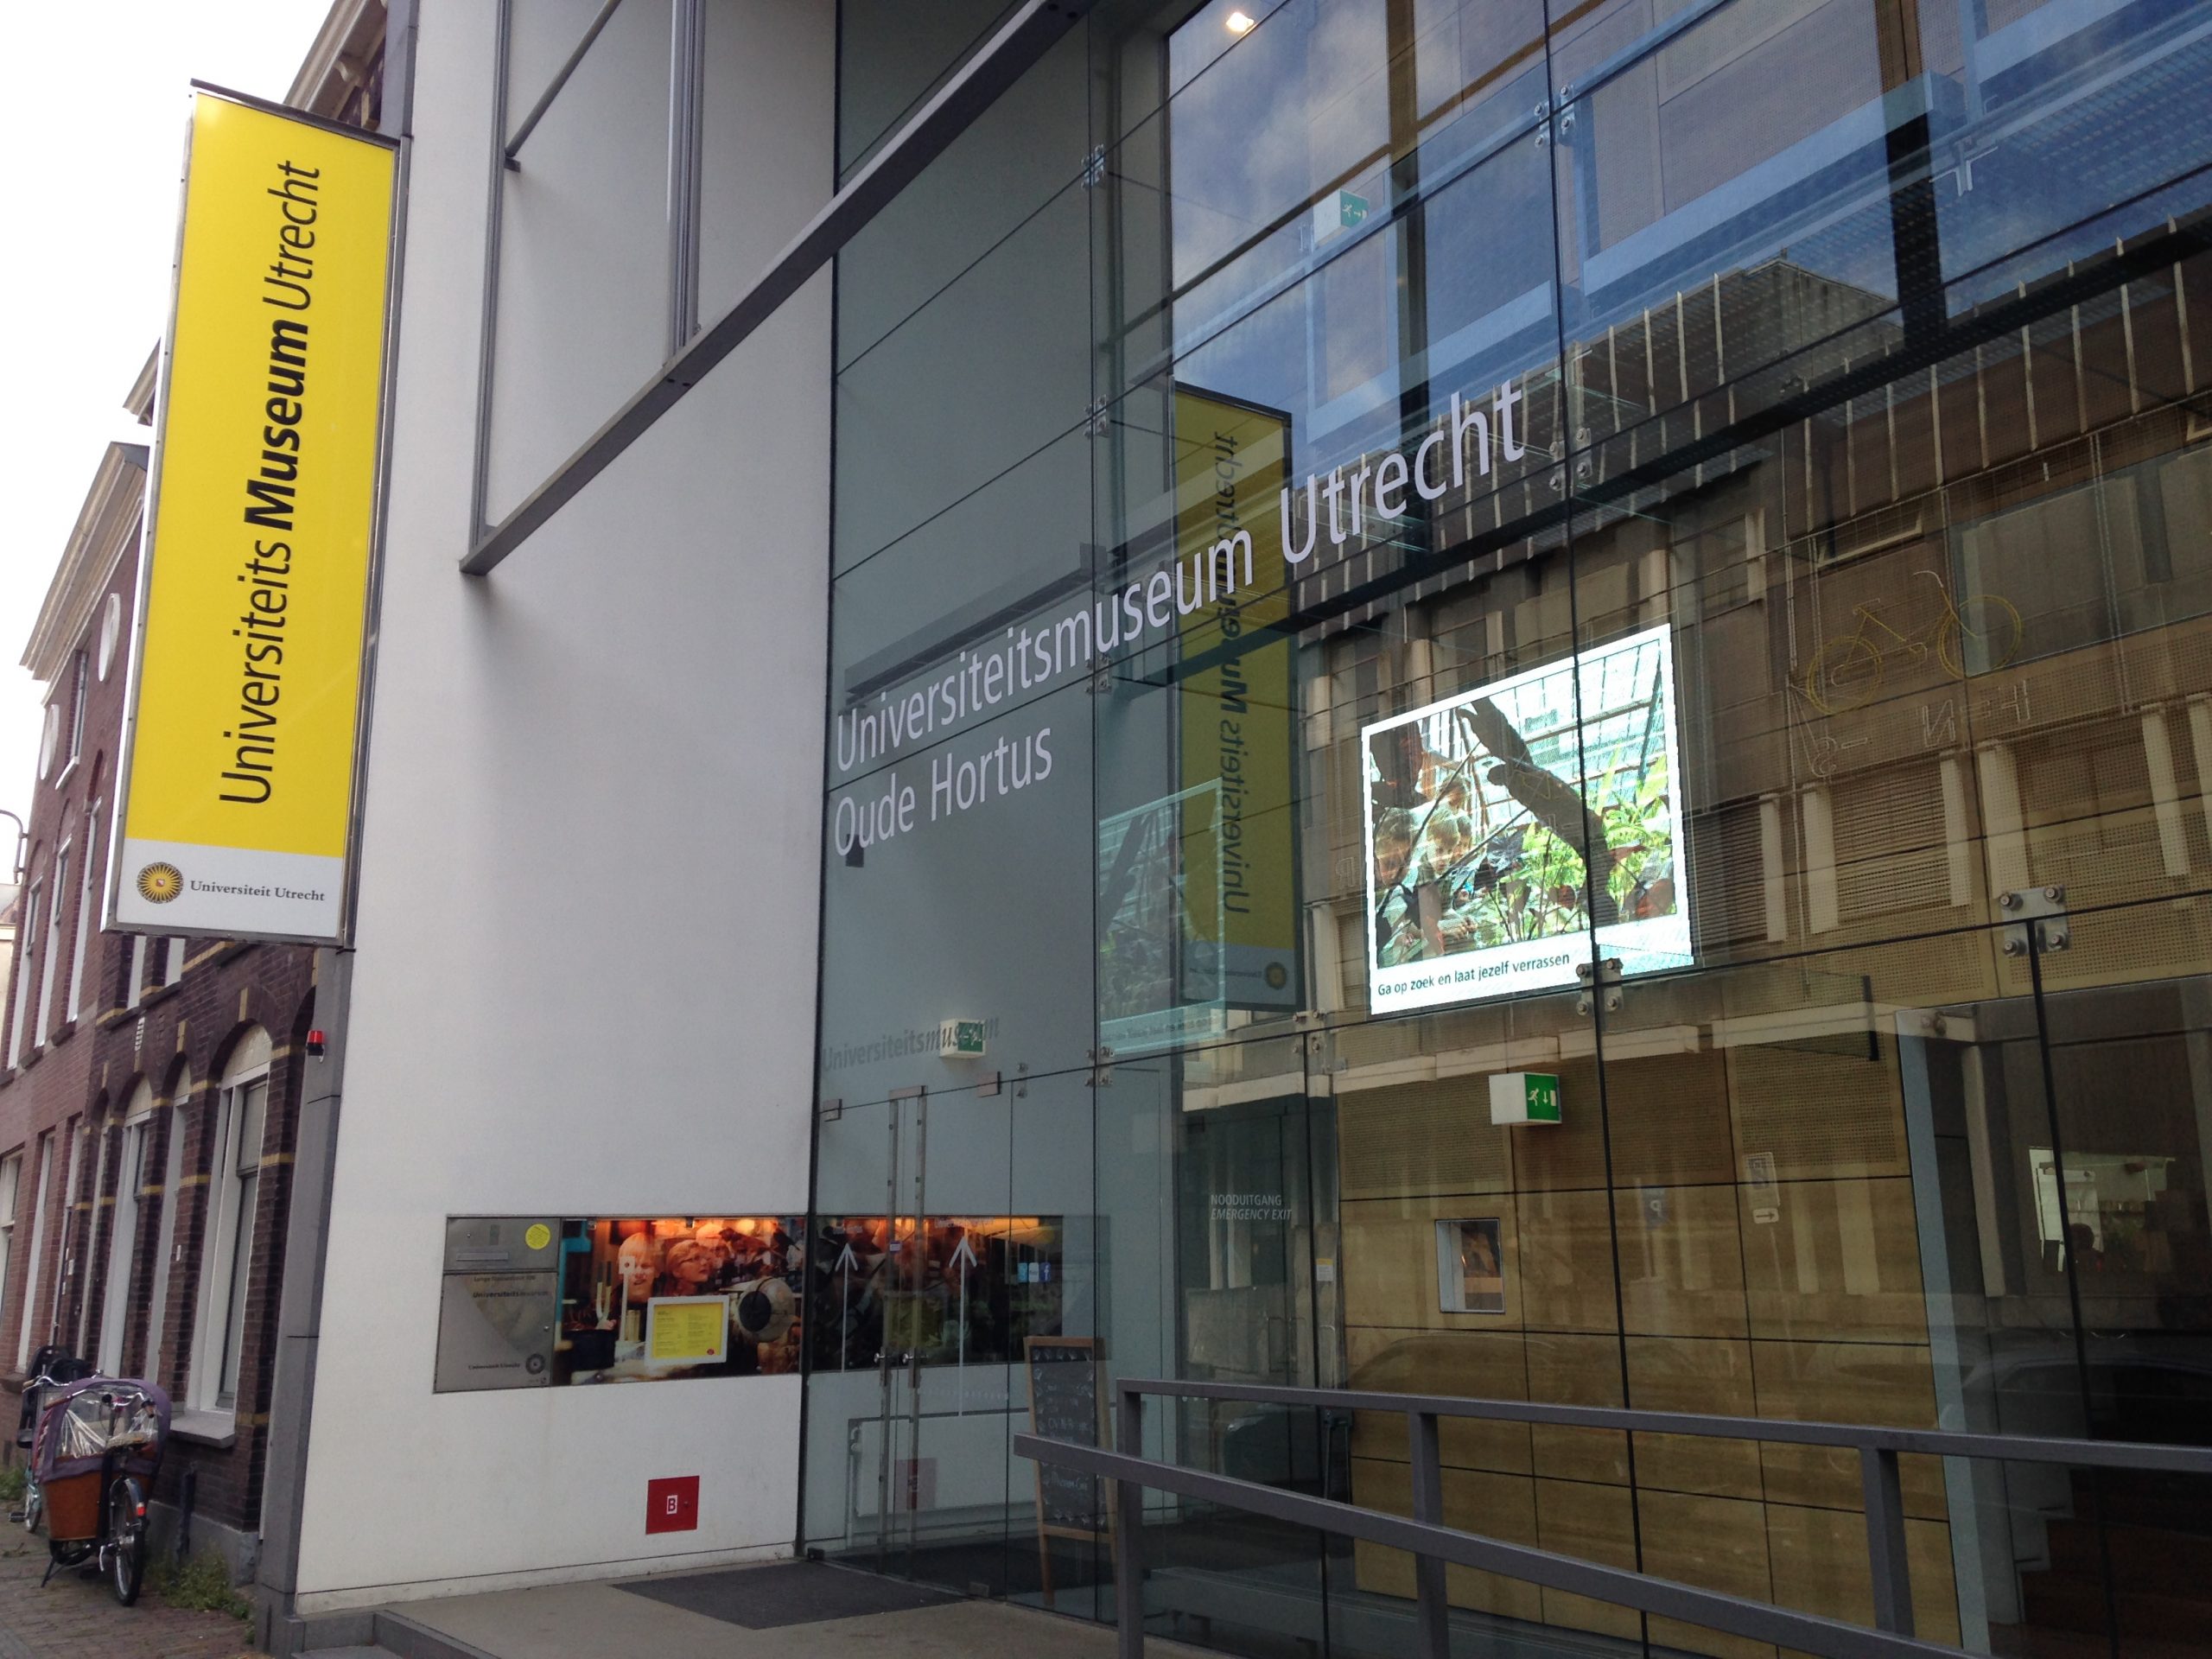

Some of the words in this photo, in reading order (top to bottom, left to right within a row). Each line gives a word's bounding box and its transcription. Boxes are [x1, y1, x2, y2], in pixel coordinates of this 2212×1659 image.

[262, 160, 321, 311] Utrecht
[243, 319, 308, 531] Museum
[836, 527, 1253, 772] Universiteitsmuseum
[1279, 379, 1523, 564] Utrecht
[219, 539, 292, 804] Universiteits
[833, 773, 916, 856] Oude
[930, 726, 1053, 823] Hortus
[189, 880, 270, 898] Universiteit
[274, 887, 326, 901] Utrecht
[1377, 983, 1392, 996] Ga
[1394, 982, 1408, 995] op
[1410, 976, 1434, 991] zoek
[1438, 974, 1452, 986] en
[1454, 969, 1476, 983] laat
[1477, 961, 1510, 981] jezelf
[1513, 953, 1570, 973] verrassen
[1211, 1194, 1281, 1206] NOODUITGANG
[1211, 1209, 1271, 1220] EMERGENCY
[1271, 1209, 1293, 1220] EXIT
